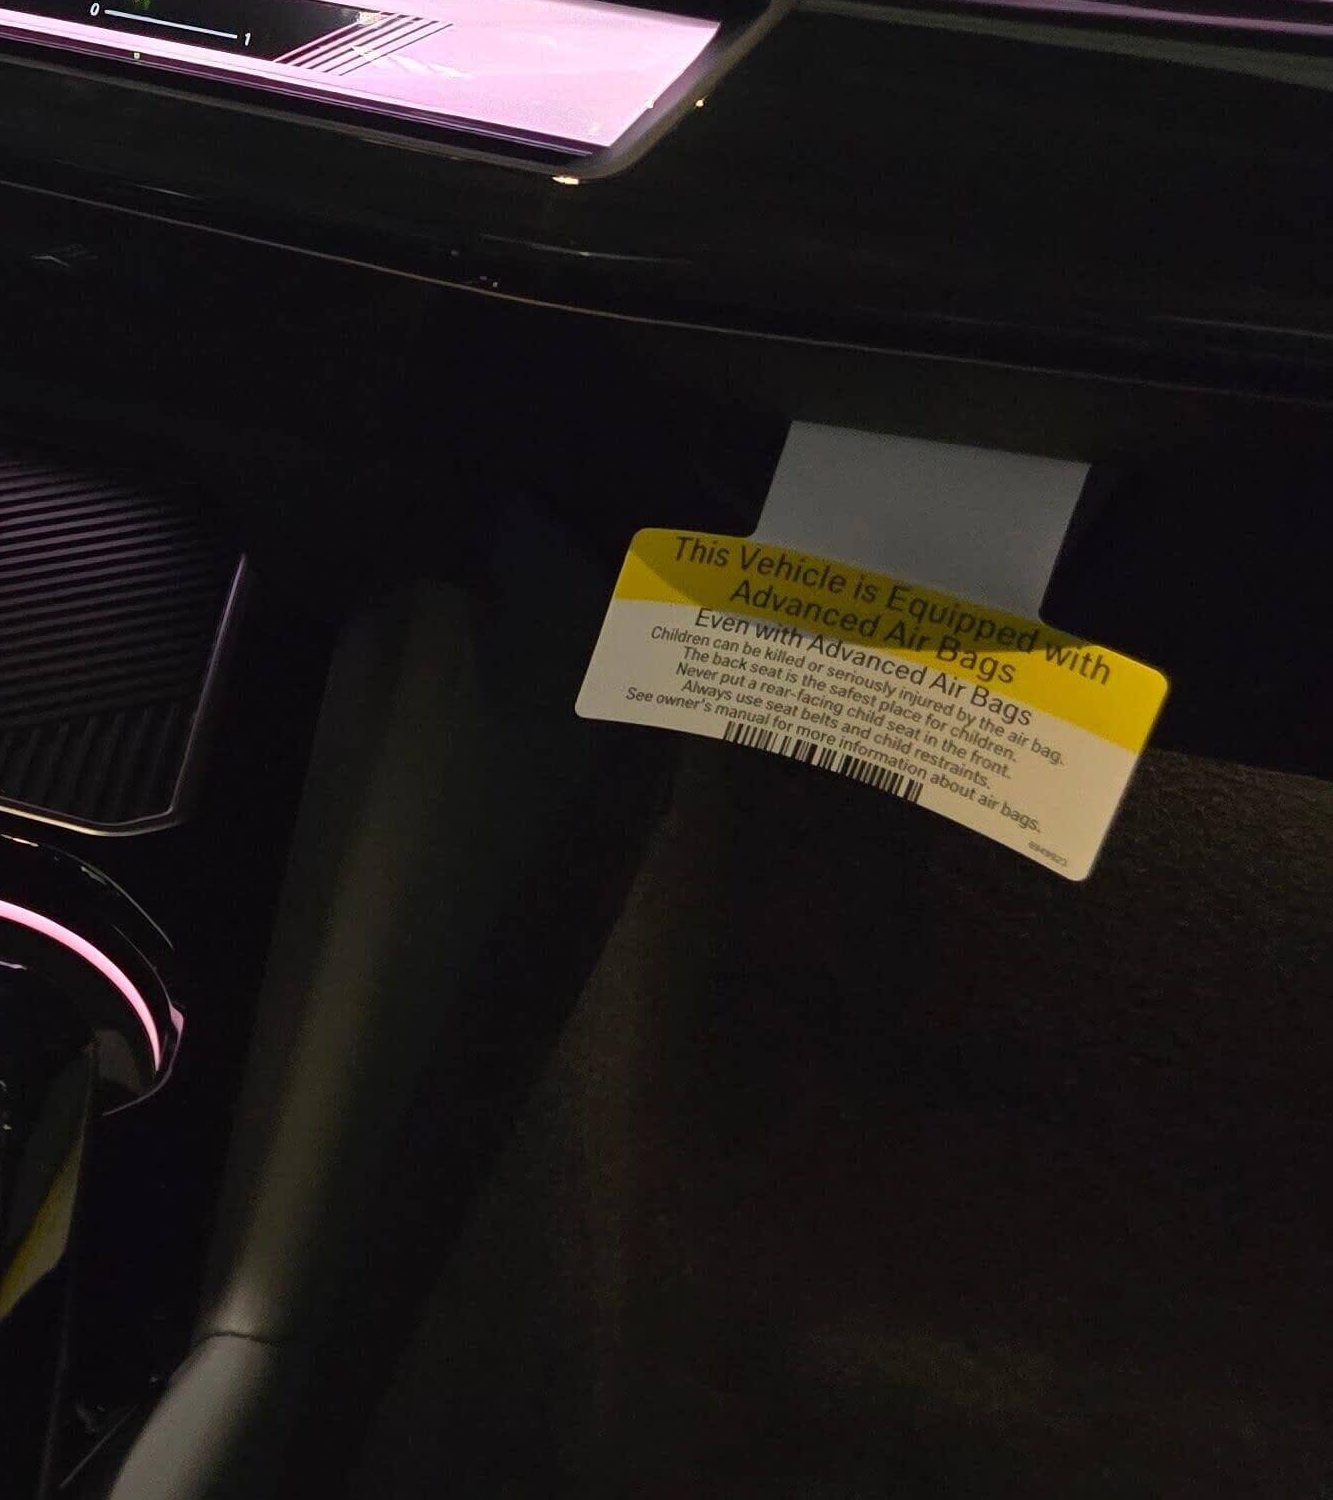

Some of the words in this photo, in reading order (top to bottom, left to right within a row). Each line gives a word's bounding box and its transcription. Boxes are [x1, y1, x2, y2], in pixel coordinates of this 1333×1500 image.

[675, 536, 732, 568] This
[740, 544, 848, 595] Vehicle
[853, 575, 879, 604] is
[886, 583, 1040, 654] Equipped
[1044, 641, 1111, 686] with
[694, 607, 749, 636] Even
[755, 623, 805, 649] with
[806, 634, 928, 686] Advanced
[929, 672, 967, 699] Air
[969, 684, 1033, 726] Bags
[729, 579, 882, 638] Advanced
[885, 620, 932, 652] Air
[935, 634, 1017, 684] Bags
[651, 625, 710, 647] Children
[713, 638, 740, 653] can
[742, 641, 762, 658] be
[764, 646, 806, 669] killed
[807, 660, 825, 674] or
[826, 665, 897, 699] seriously
[898, 686, 955, 717] injured
[956, 706, 978, 728] by
[978, 716, 1005, 737] the
[1007, 730, 1030, 747] air
[1030, 737, 1065, 766] bag.
[675, 661, 719, 681] Never
[719, 672, 746, 688] put
[747, 680, 758, 690] a
[760, 681, 844, 717] rear-facing
[846, 706, 886, 727] child
[886, 720, 922, 741] seat
[924, 730, 939, 748] in
[941, 739, 968, 759] the
[971, 749, 1012, 780] front.
[681, 679, 733, 702] Always
[735, 693, 763, 708] use
[765, 699, 799, 717] seat
[800, 706, 840, 730] belts
[841, 722, 873, 740] and
[874, 733, 913, 755] child
[914, 747, 992, 790] restraints.
[684, 645, 710, 663] The
[712, 651, 748, 671] back
[749, 662, 783, 680] seat
[785, 668, 798, 684] is
[801, 673, 827, 691] the
[828, 684, 878, 708] safest
[878, 700, 923, 723] place
[924, 713, 949, 732] for
[950, 725, 1017, 762] children.
[625, 686, 654, 703] See
[656, 693, 713, 713] owner's
[714, 703, 771, 725] manual
[771, 714, 795, 733] for
[795, 724, 837, 746] more
[838, 735, 929, 780] information
[929, 773, 976, 800] about
[977, 793, 1001, 811] air
[999, 801, 1041, 833] bags.
